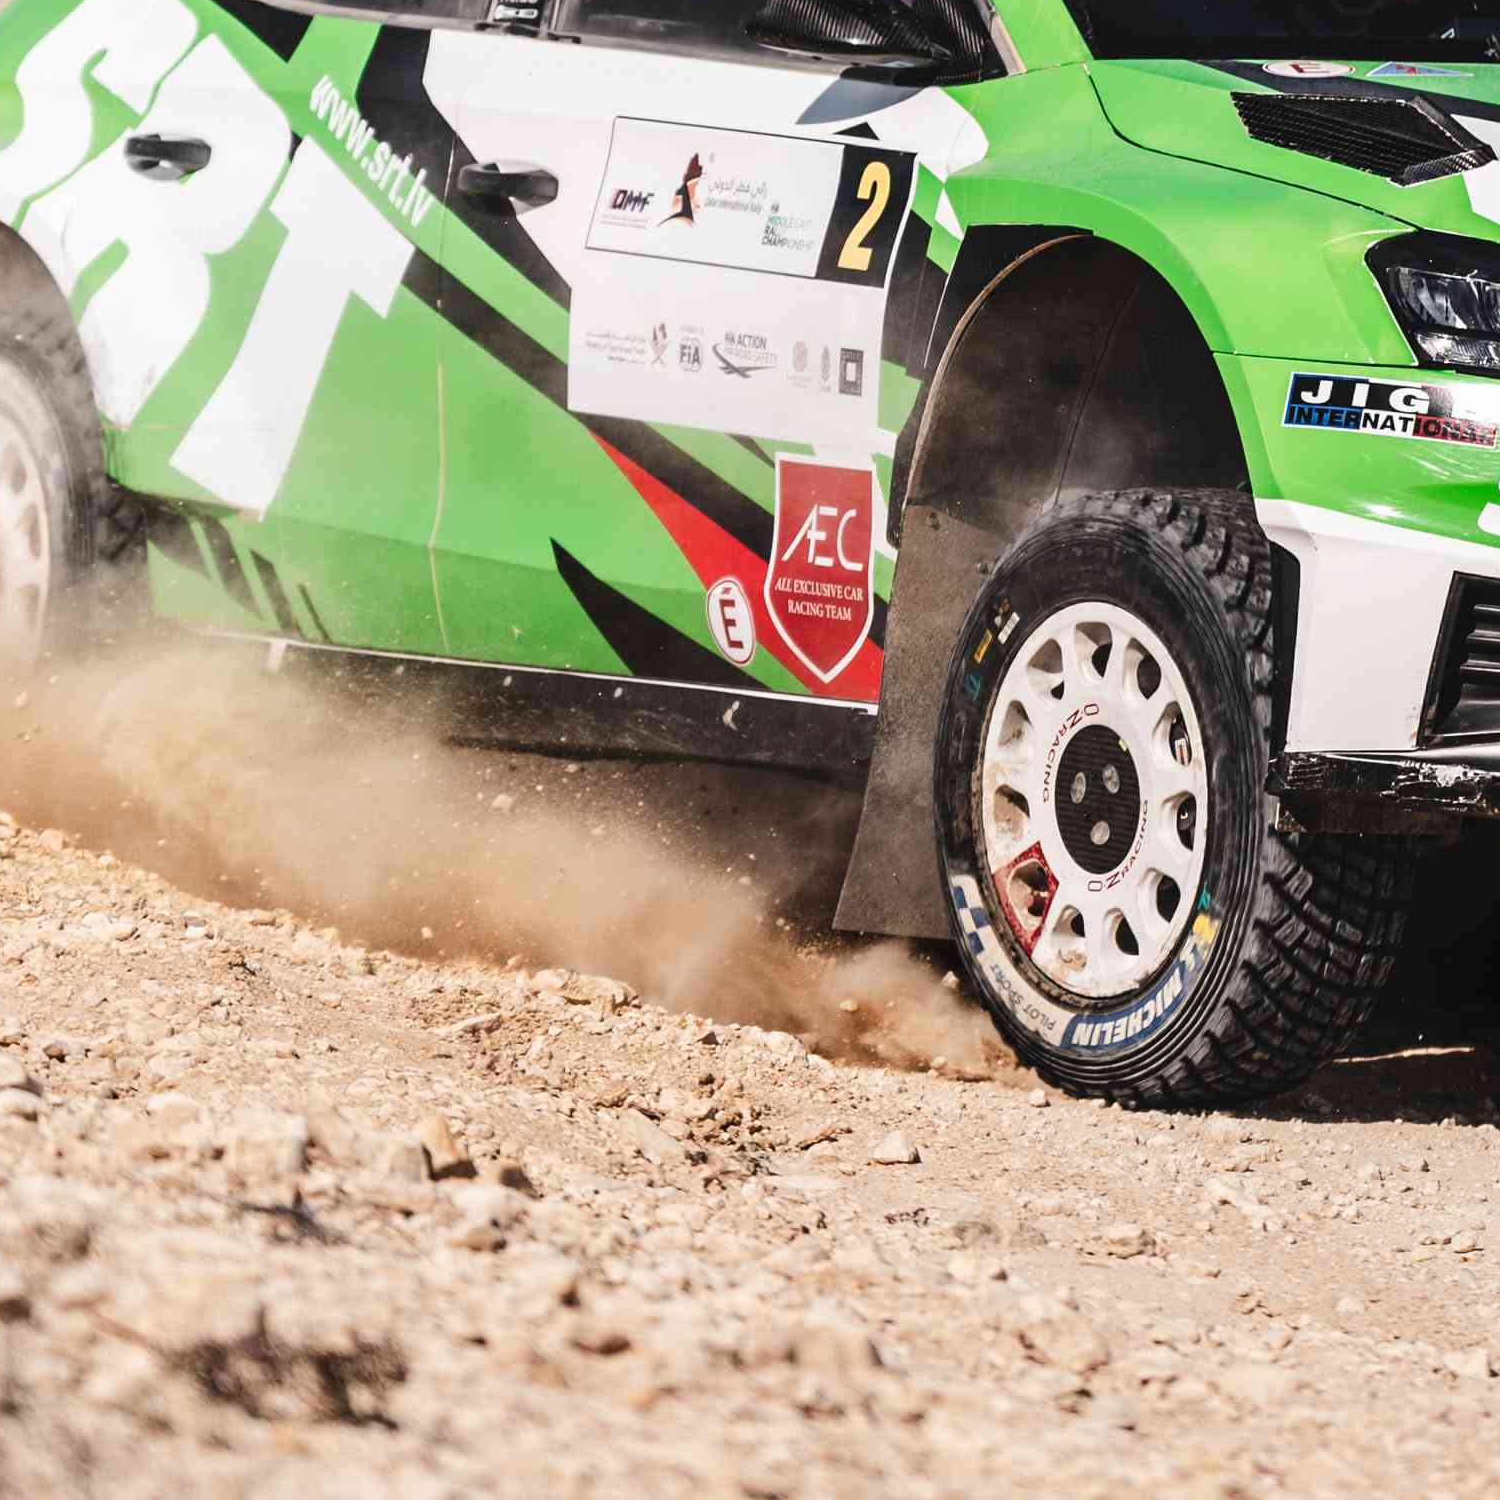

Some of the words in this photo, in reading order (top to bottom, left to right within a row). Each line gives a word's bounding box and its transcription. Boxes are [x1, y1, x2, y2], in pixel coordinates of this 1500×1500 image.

[309, 74, 437, 228] www.srt.lv
[837, 161, 891, 272] 2
[736, 333, 767, 351] ACTION
[775, 577, 792, 593] ALL
[793, 579, 844, 600] EXCLUSIVE
[844, 586, 864, 602] CAR
[787, 599, 823, 618] RACING
[824, 604, 852, 621] TEAM
[1071, 967, 1185, 1047] MICHELIN
